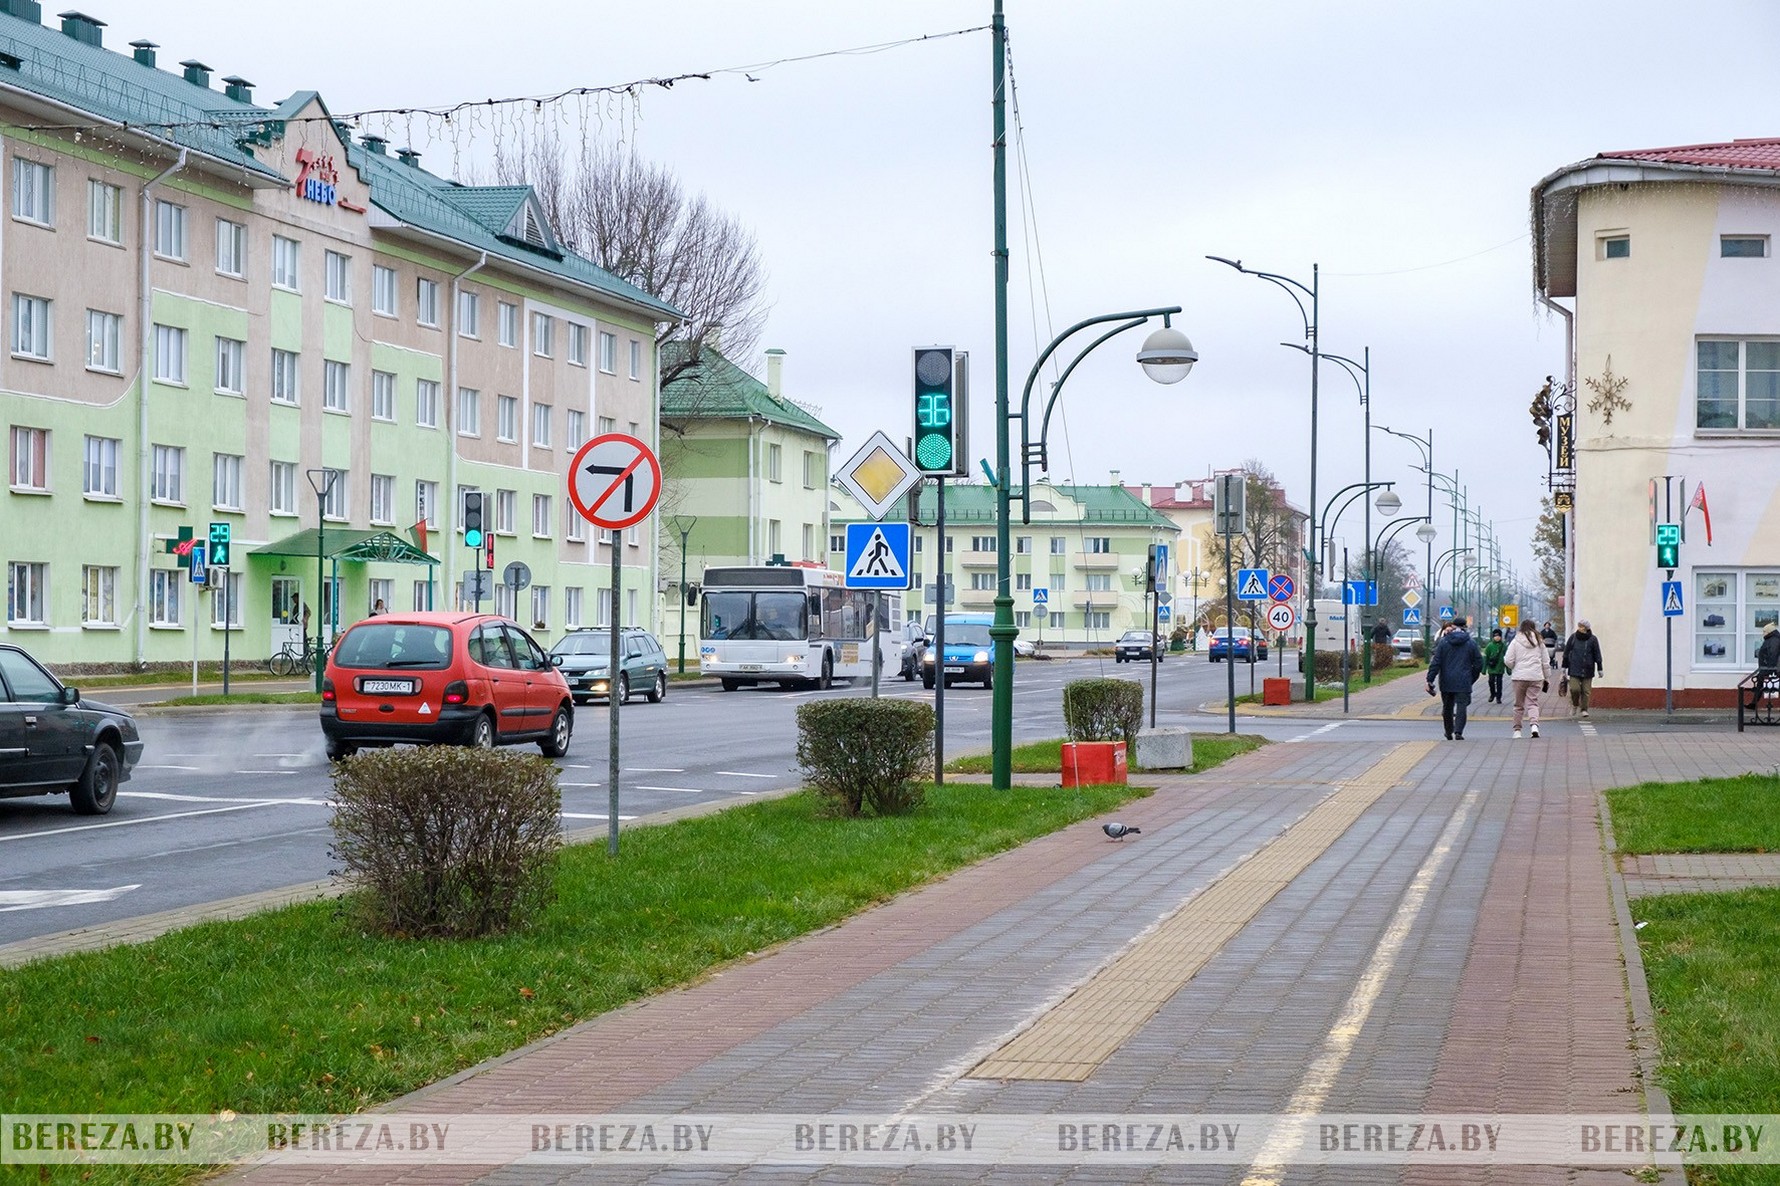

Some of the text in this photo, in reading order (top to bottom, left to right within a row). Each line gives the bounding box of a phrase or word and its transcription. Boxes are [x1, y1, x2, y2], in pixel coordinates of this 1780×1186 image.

[305, 178, 336, 206] НЕБО
[918, 395, 950, 426] 36
[1559, 416, 1571, 467] МУЗЕЙ
[210, 524, 229, 543] 29
[1658, 526, 1678, 545] 29
[1272, 611, 1289, 623] 40
